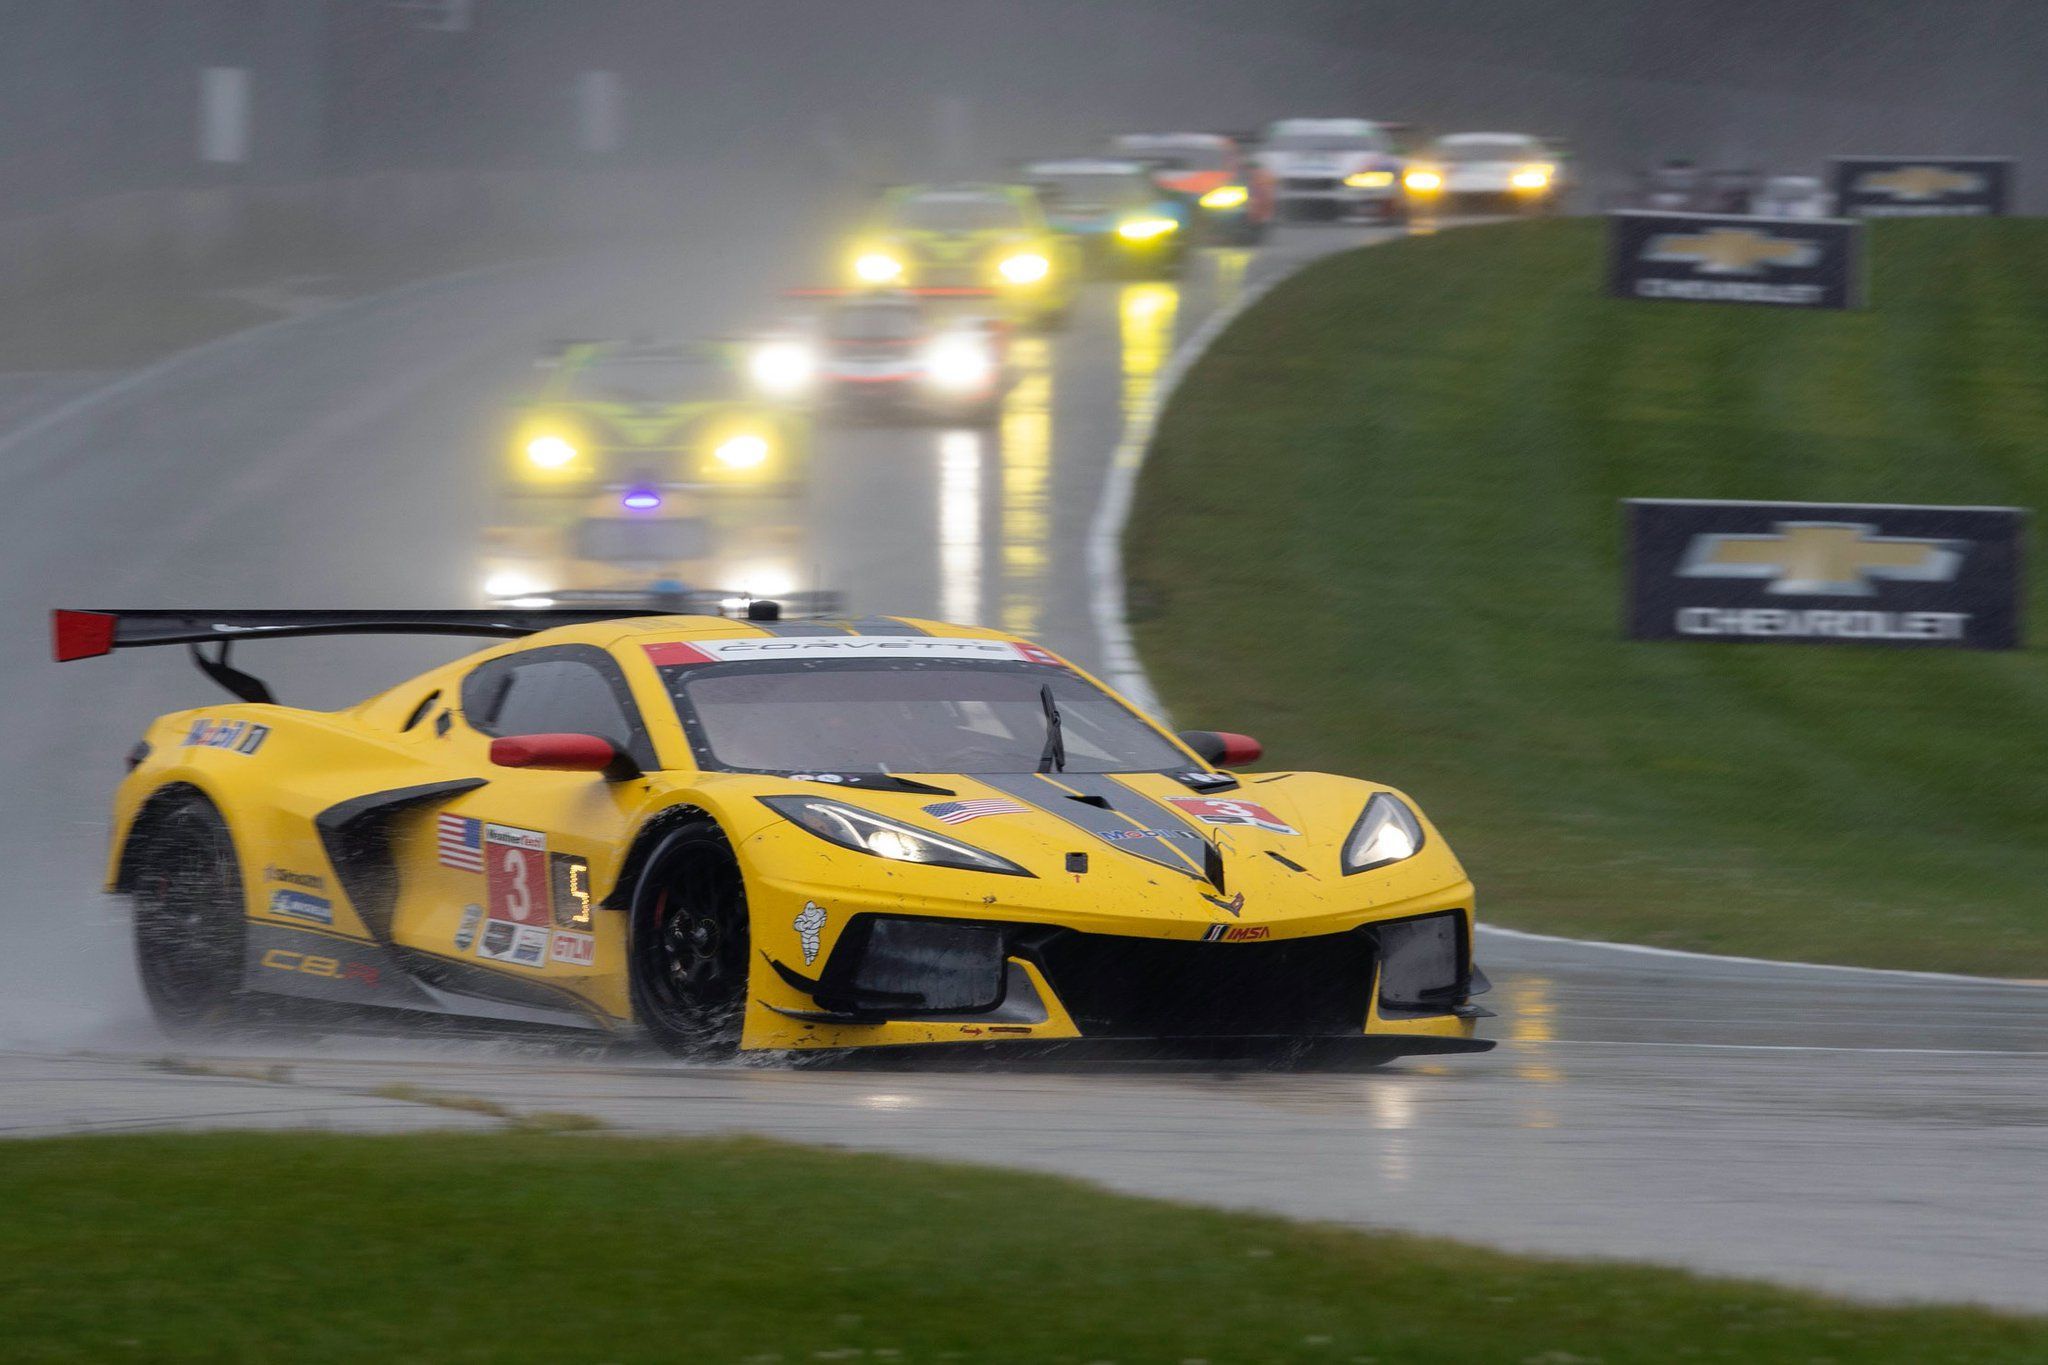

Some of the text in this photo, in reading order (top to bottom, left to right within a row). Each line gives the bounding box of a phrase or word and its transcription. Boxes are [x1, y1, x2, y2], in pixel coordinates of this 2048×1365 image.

[718, 641, 1010, 654] CORVETTE
[1204, 801, 1254, 817] 3
[504, 849, 531, 921] 3
[569, 863, 591, 923] 5
[1226, 925, 1270, 941] IMSA
